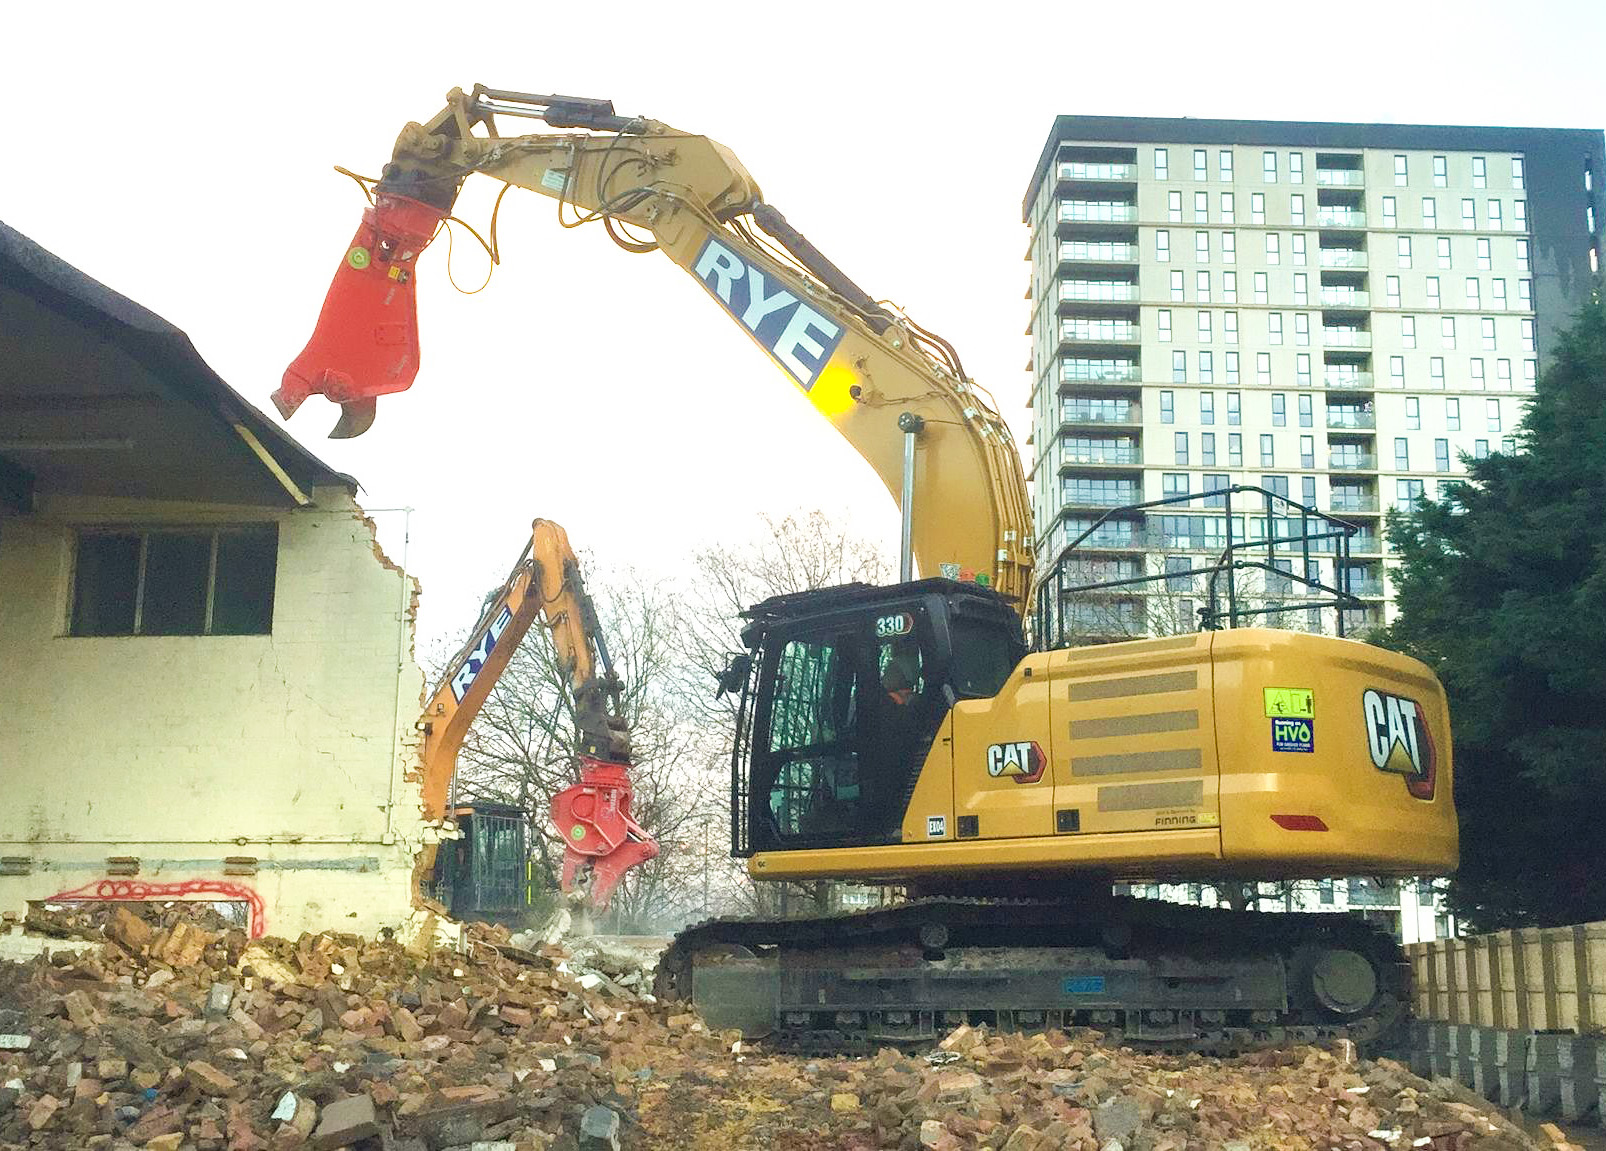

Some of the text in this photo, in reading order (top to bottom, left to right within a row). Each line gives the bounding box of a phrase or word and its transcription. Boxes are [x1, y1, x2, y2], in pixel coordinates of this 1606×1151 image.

[695, 239, 840, 385] RYE
[451, 607, 511, 701] RYE
[876, 615, 904, 634] 330
[988, 742, 1032, 777] CAT
[1275, 722, 1311, 742] HVO
[1363, 690, 1421, 774] CAT
